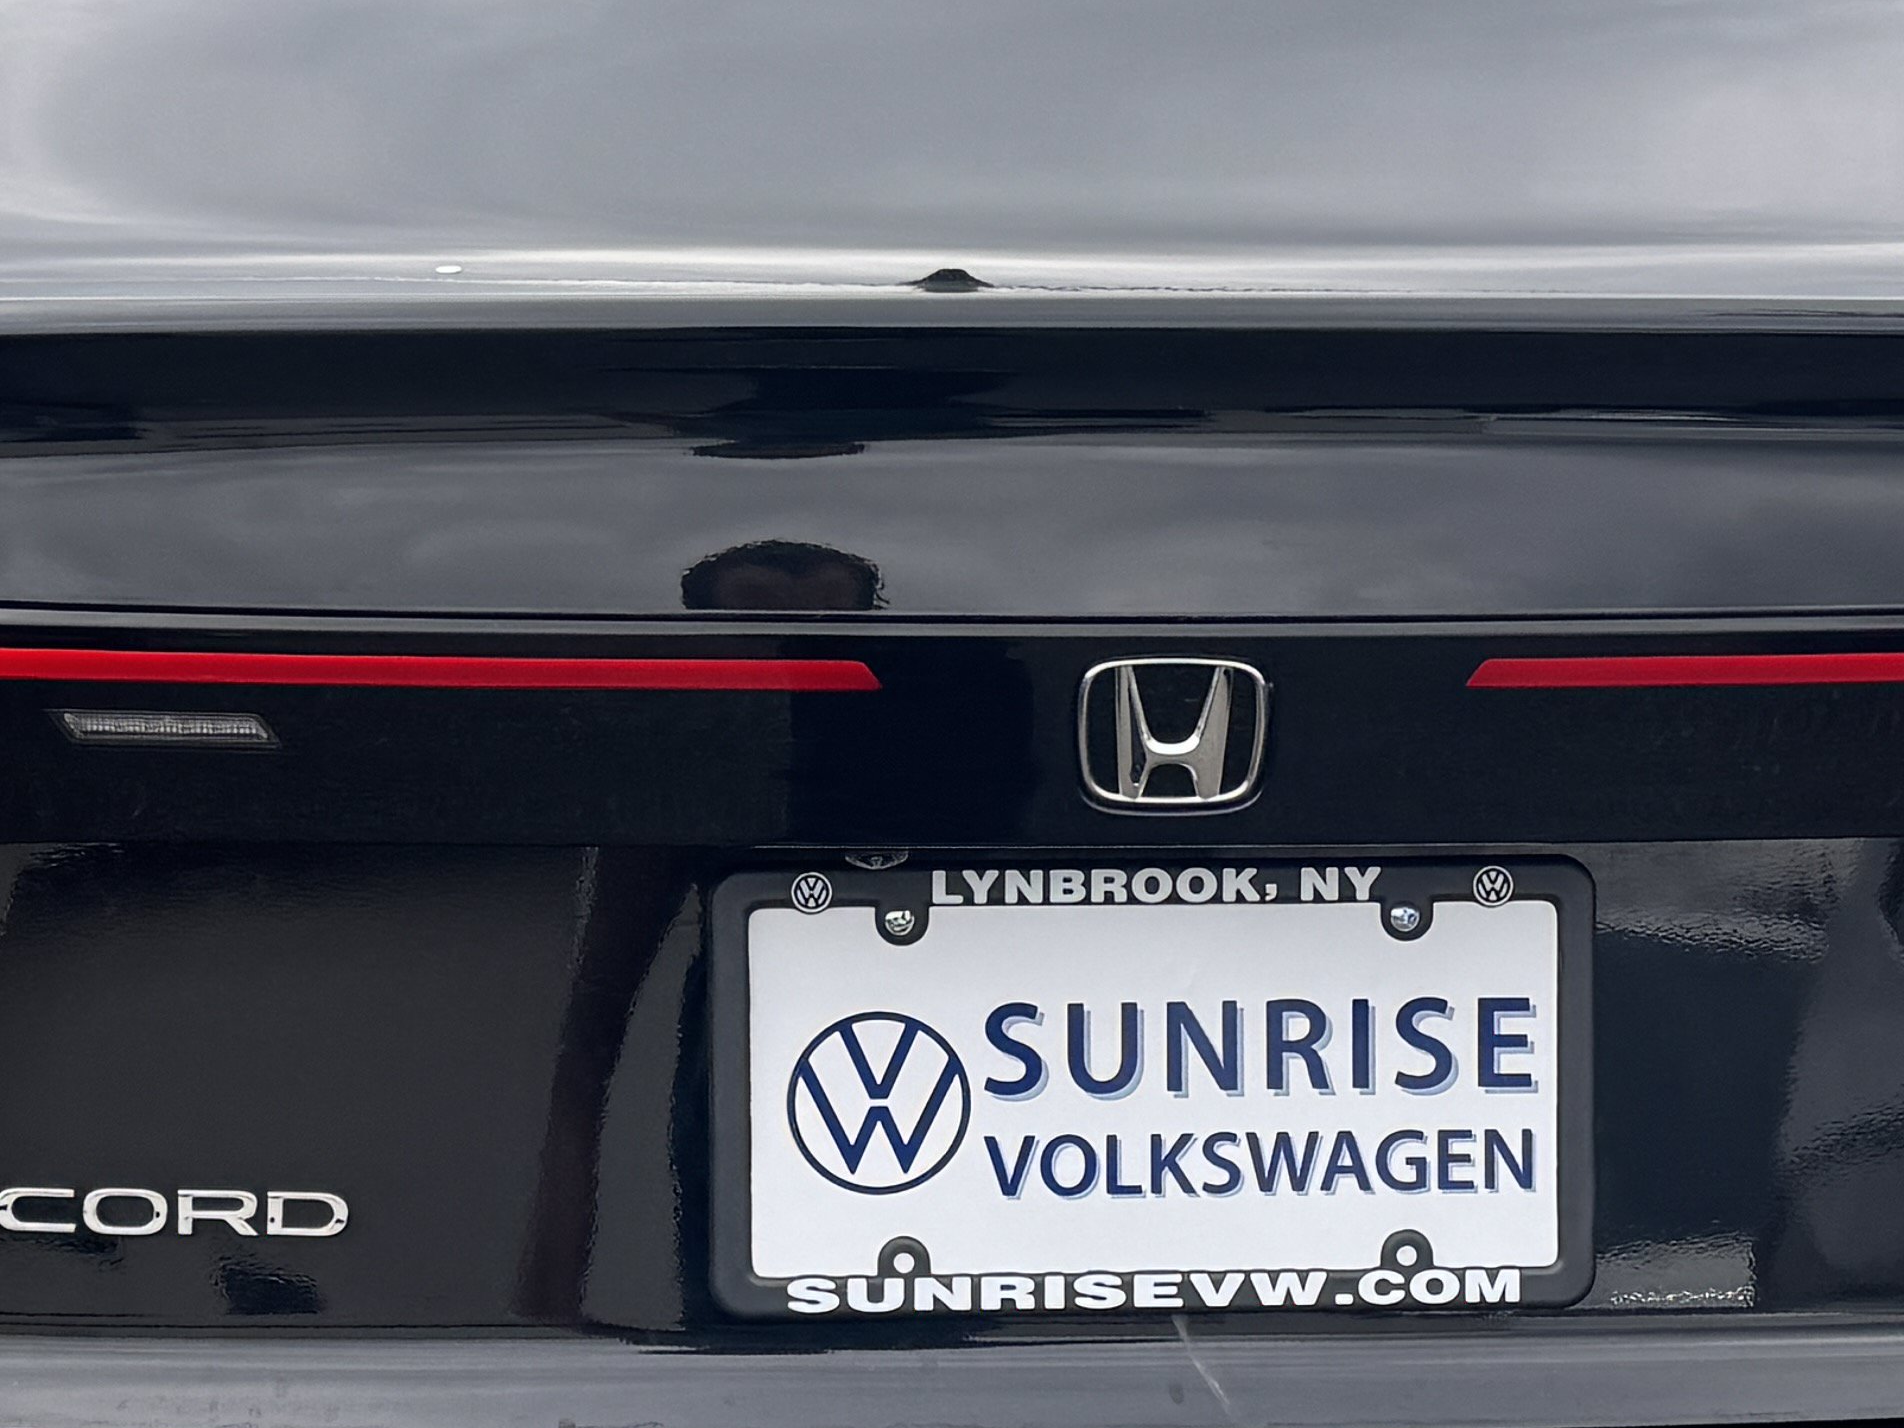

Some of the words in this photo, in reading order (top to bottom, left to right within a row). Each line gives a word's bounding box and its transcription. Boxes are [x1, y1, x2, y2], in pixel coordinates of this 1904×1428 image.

[791, 872, 834, 914] VW
[931, 867, 1278, 905] LYNBROOK,
[1299, 865, 1382, 903] NY
[1473, 865, 1515, 907] VW
[983, 996, 1539, 1102] SUNRISE
[787, 1011, 972, 1196] VW
[983, 1128, 1537, 1201] VOLKSWAGEN
[786, 1268, 1522, 1314] SUNRISEVW.COM
